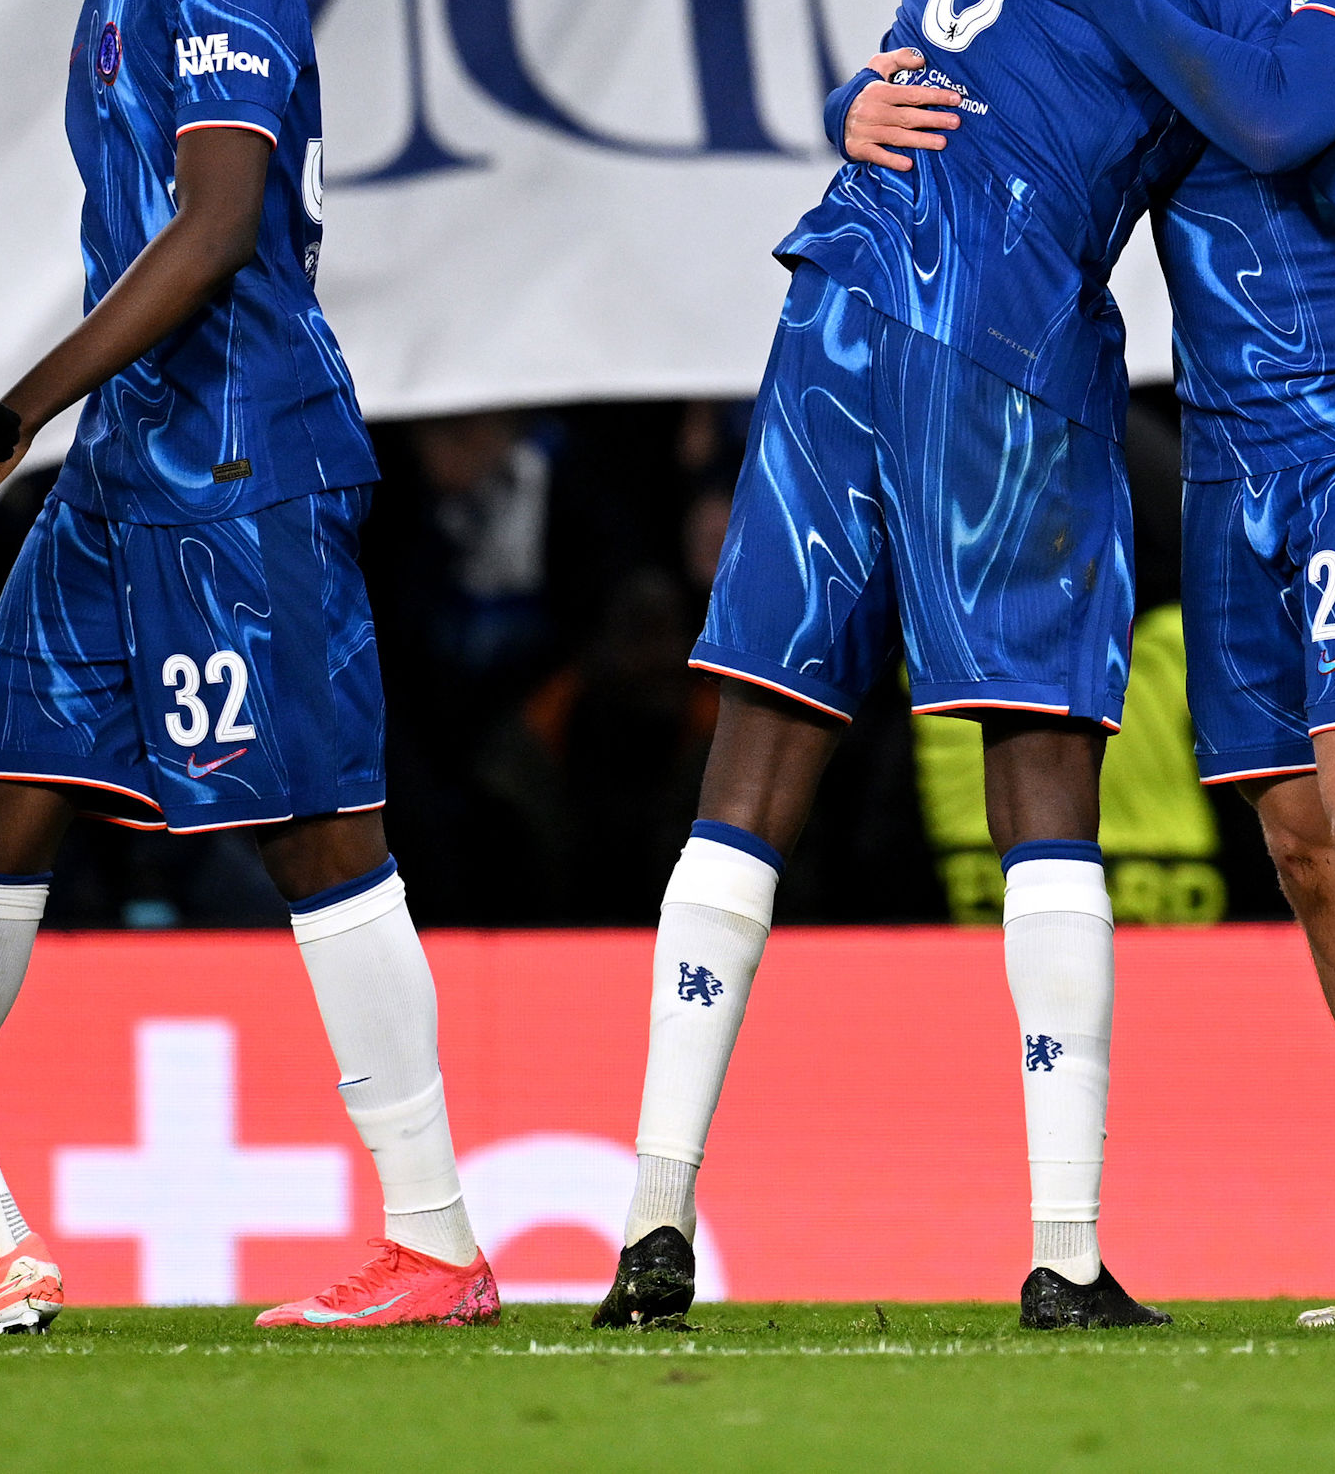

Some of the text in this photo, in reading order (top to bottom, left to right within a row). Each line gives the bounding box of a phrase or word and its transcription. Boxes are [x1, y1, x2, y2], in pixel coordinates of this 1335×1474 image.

[176, 33, 229, 58] LIVE
[179, 51, 270, 77] NATION
[162, 650, 257, 748] 32
